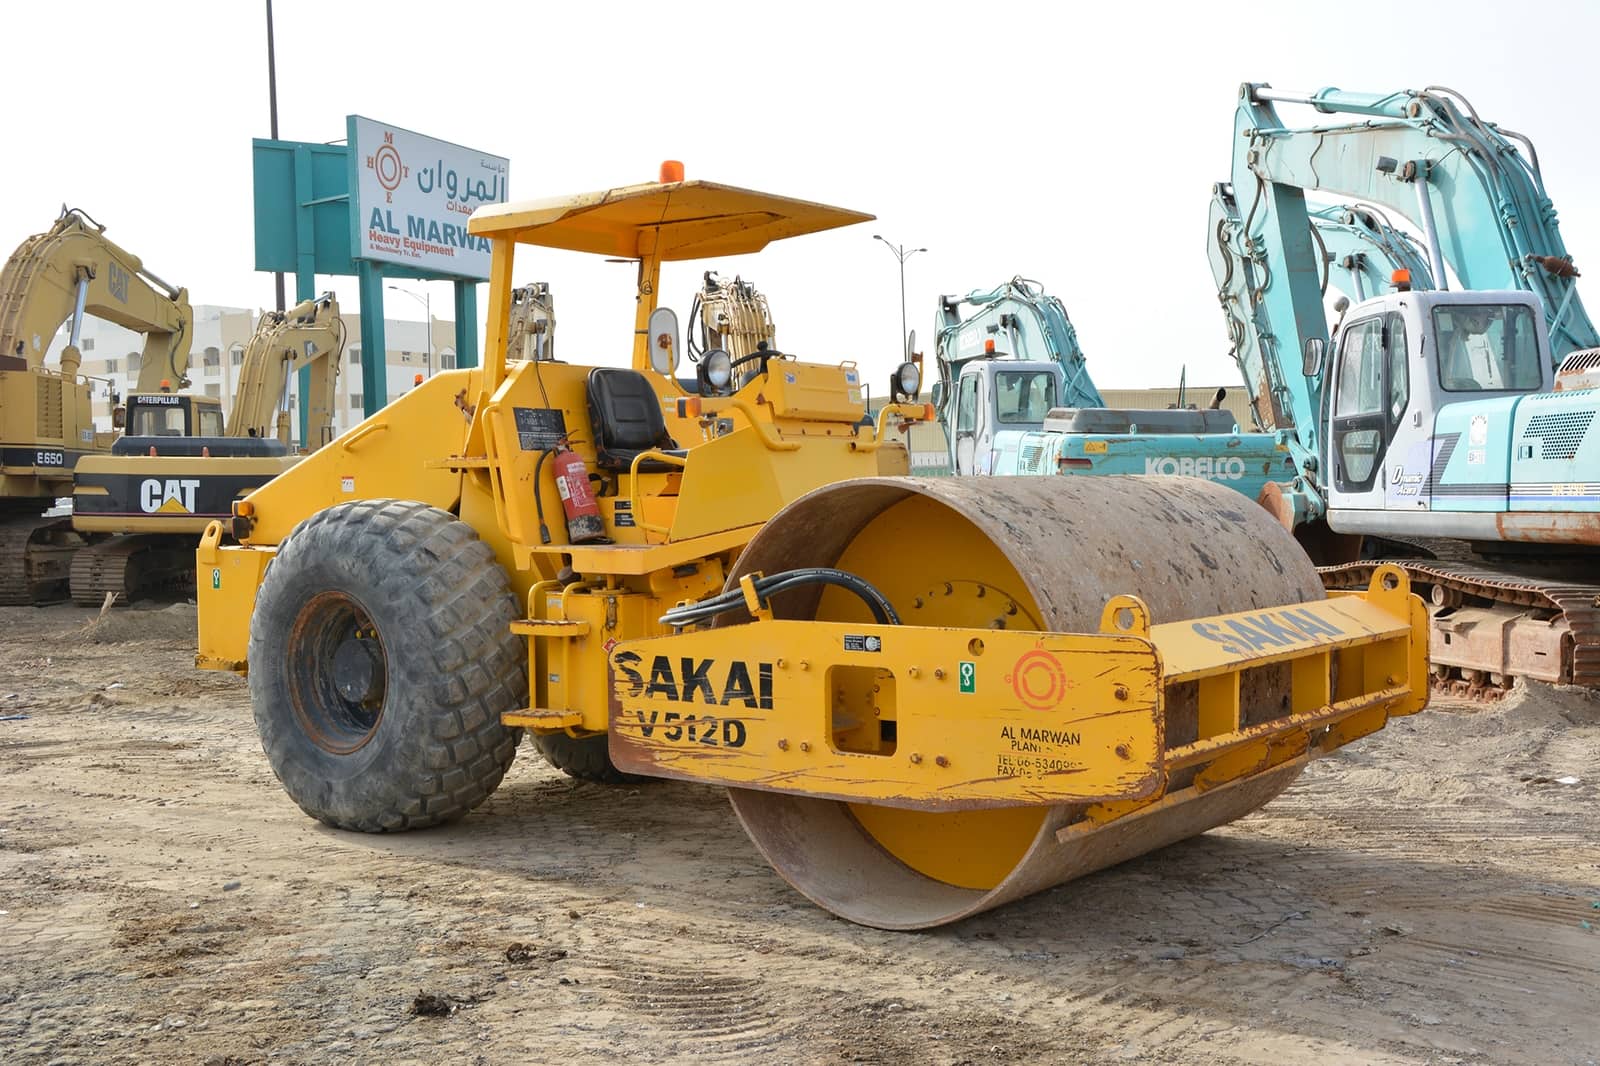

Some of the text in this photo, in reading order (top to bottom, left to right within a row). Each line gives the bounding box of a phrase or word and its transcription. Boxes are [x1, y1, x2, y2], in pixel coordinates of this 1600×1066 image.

[384, 131, 393, 144] M
[403, 165, 409, 178] T
[417, 159, 505, 203] المروان
[386, 192, 393, 204] E
[369, 207, 492, 254] AL MARWA
[368, 230, 455, 257] Heavy Equipment
[137, 396, 179, 405] CATERPILLAR
[37, 452, 63, 465] E650
[1145, 457, 1246, 480] KOBELCO
[140, 478, 200, 513] CAT
[1191, 607, 1346, 655] SAKAI
[614, 651, 773, 710] SAKAI
[625, 710, 747, 748] V512D
[1001, 726, 1081, 746] AL MARWAN
